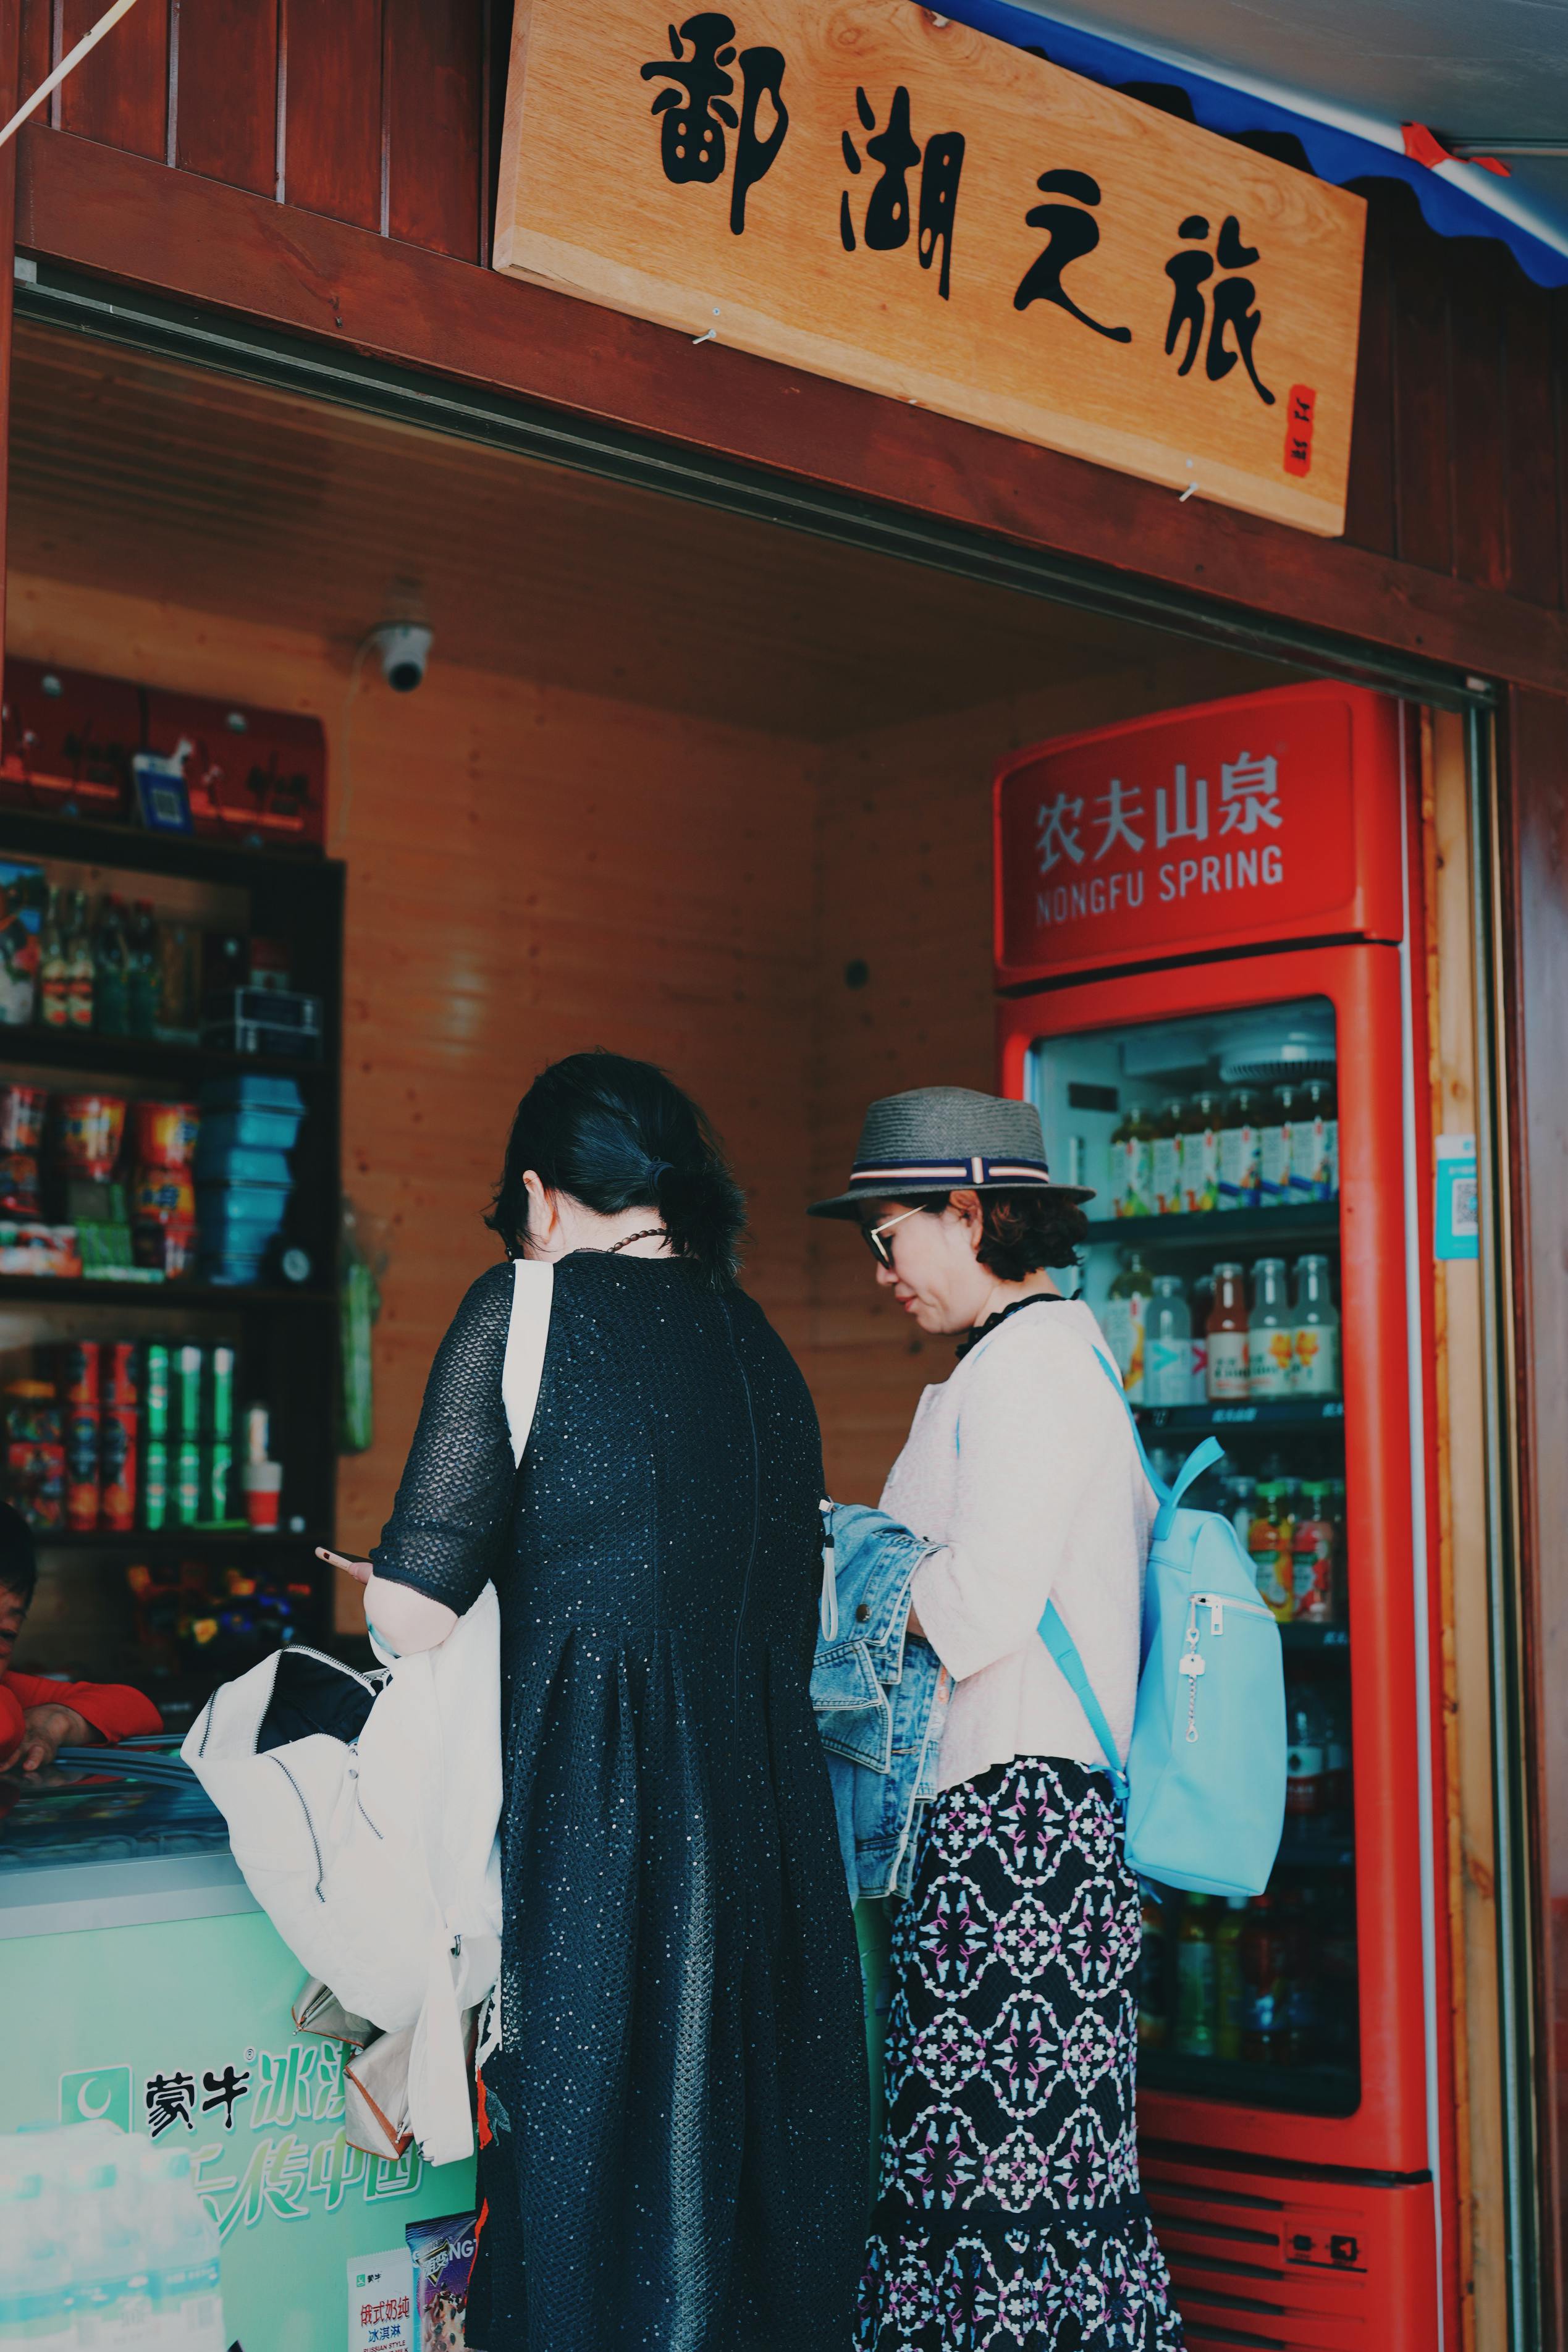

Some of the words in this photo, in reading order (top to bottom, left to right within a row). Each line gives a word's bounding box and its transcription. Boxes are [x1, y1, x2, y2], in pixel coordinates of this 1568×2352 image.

[1036, 751, 1282, 873] 农夫山泉
[1037, 871, 1144, 927] NONGFU
[1160, 846, 1283, 901] SPRING
[146, 2065, 250, 2138] 蒙牛
[361, 2296, 410, 2327] 俄式奶纯
[368, 2324, 401, 2343] 冰淇淋
[389, 2340, 405, 2349] STYLE
